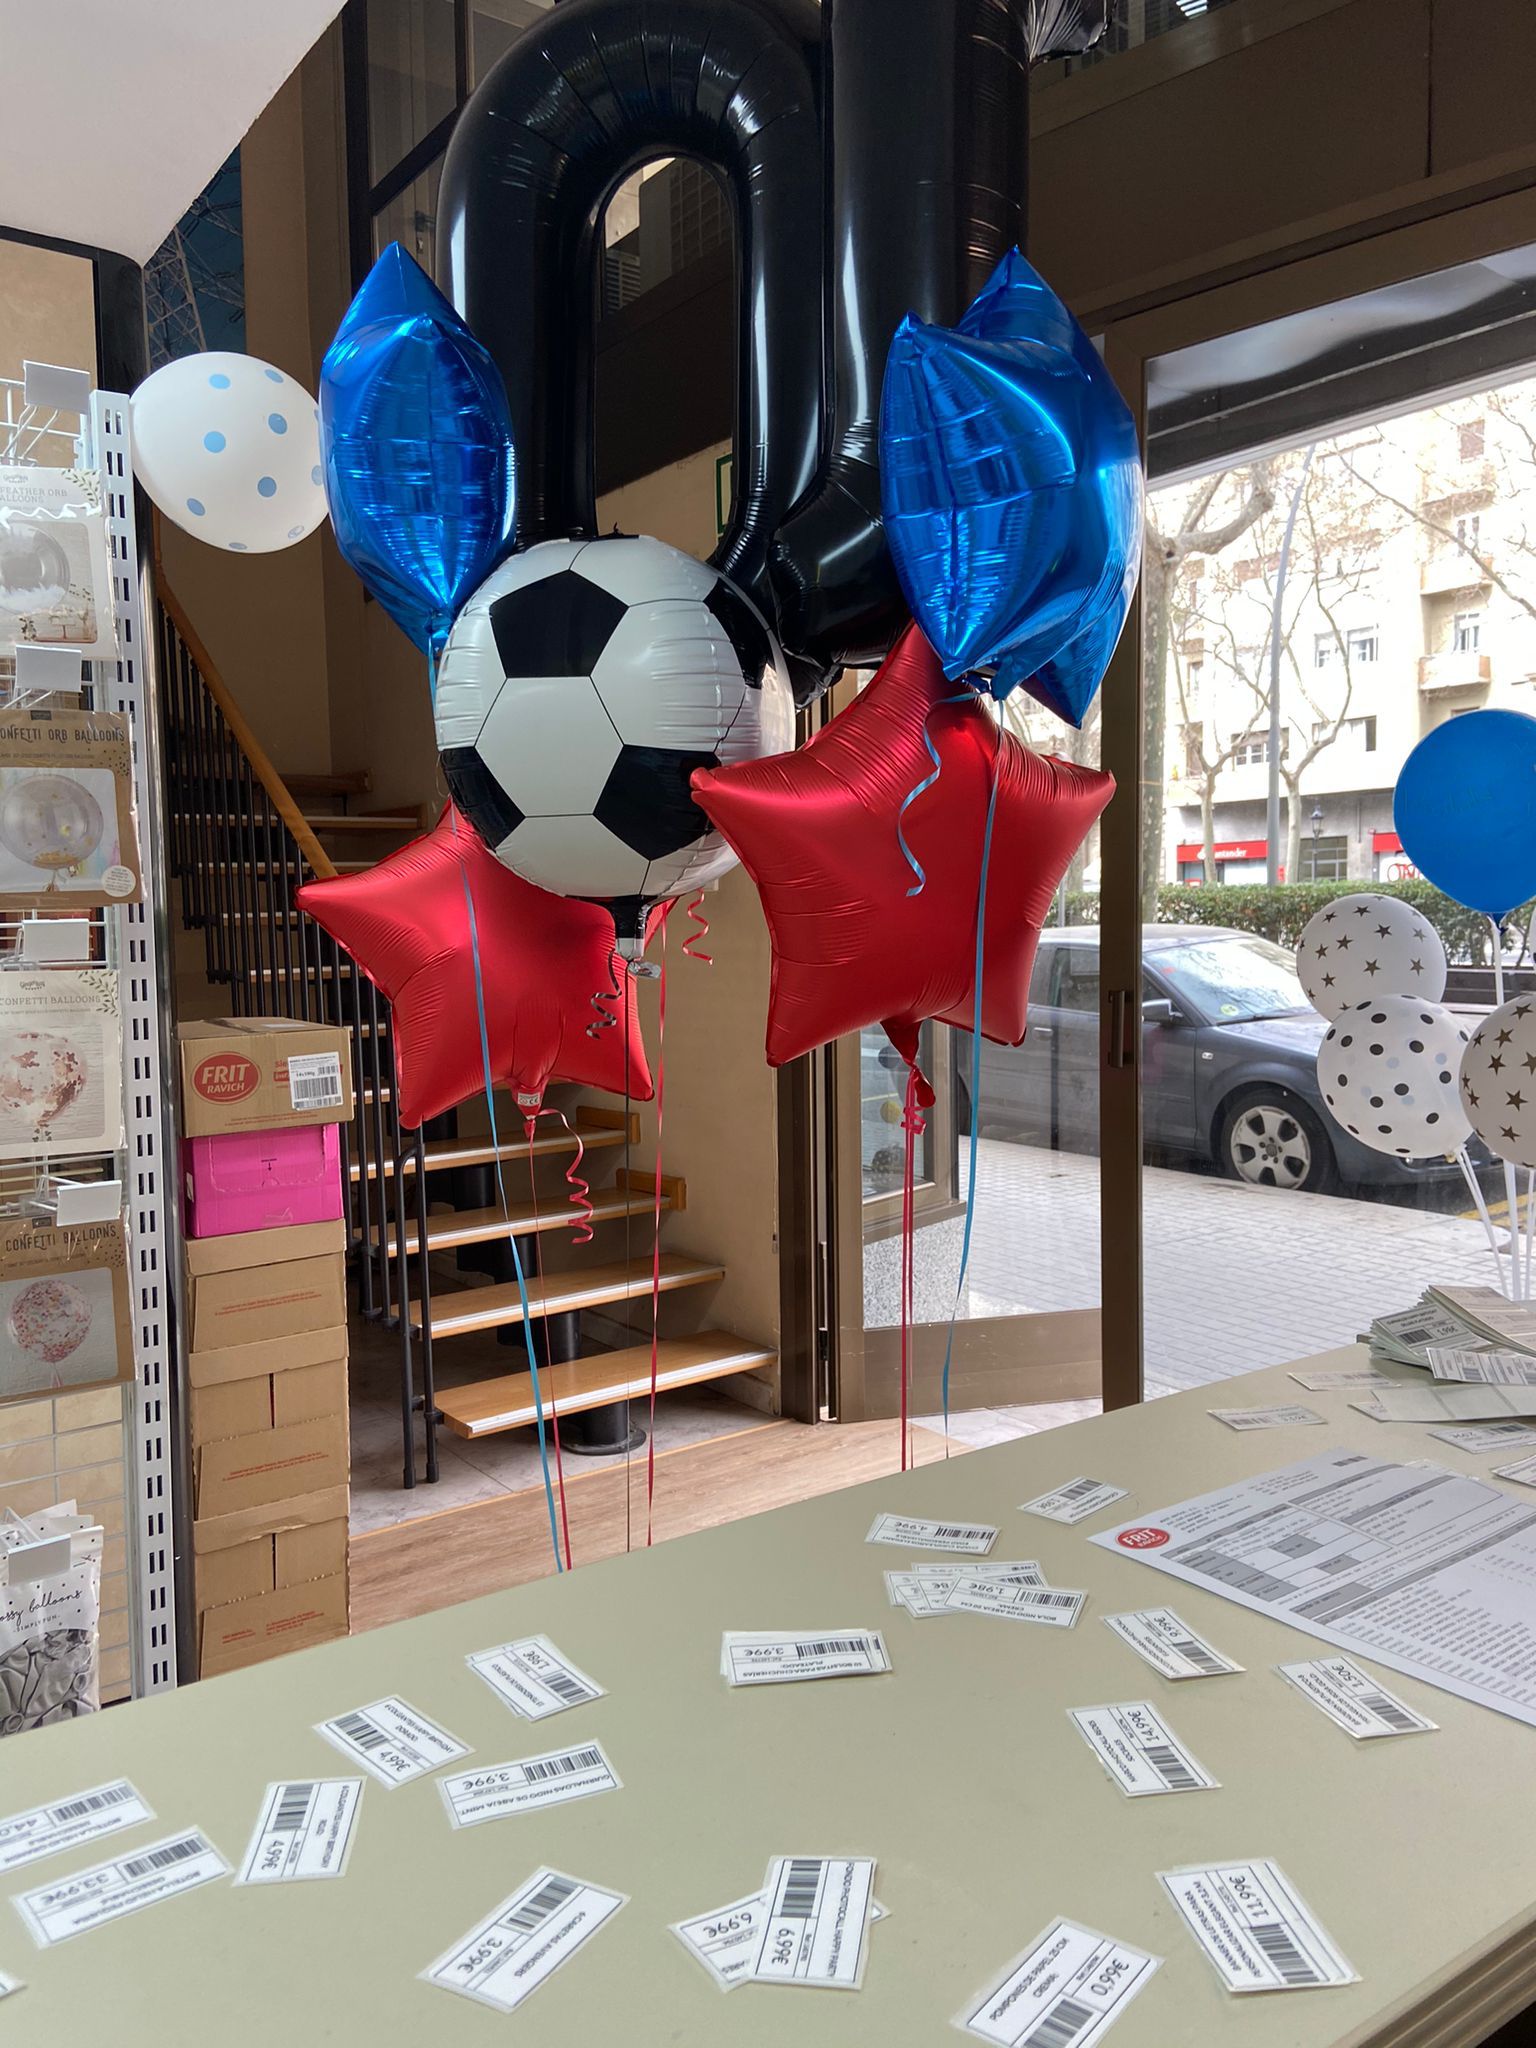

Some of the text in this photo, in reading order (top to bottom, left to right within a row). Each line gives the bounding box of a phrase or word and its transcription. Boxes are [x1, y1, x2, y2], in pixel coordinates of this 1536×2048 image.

[0, 495, 44, 504] ALLOONS
[47, 488, 68, 497] ORB
[0, 723, 125, 744] ONFETTI ORB BALLOONS
[50, 994, 101, 1004] BALLOONS
[201, 1063, 250, 1085] FRIT
[207, 1082, 245, 1095] RAVICH
[5, 1233, 56, 1251] CONFETTI
[63, 1222, 117, 1246] BALLOONS
[1122, 1528, 1158, 1547] FRIT
[29, 1590, 83, 1613] balloons
[745, 1648, 784, 1656] 3,99€
[1332, 1665, 1364, 1687] 1,50€
[1128, 1711, 1159, 1741] 14,99€
[380, 1752, 410, 1772] 4,99€
[1114, 1739, 1135, 1762] SOCIALES
[463, 1773, 509, 1790] 3,99€
[553, 1773, 612, 1792] GUIRNALDAS
[486, 1798, 514, 1807] ABEJA
[514, 1793, 530, 1802] DE
[529, 1789, 553, 1798] NIDO
[261, 1840, 284, 1870] 4,99€
[41, 1874, 109, 1905] 33,99€
[155, 1871, 200, 1891] BOTELLA
[1185, 1891, 1201, 1910] PARA
[1229, 1876, 1269, 1917] 11,99€
[827, 1862, 855, 1978] FONDO PHOTOCALL HAPPY PARTY
[1195, 1910, 1216, 1934] LETRAS
[1204, 1900, 1228, 1929] ELEGANT
[703, 1913, 752, 1943] 6,99€
[457, 1938, 502, 1973] 3,99€
[772, 1928, 795, 1965] 6,99€
[1218, 1944, 1241, 1971] BANNER
[1223, 1929, 1262, 1977] PERSONALIZAR
[514, 1943, 552, 1977] AVENGERS
[989, 1983, 1028, 2020] POMPONES
[1021, 1975, 1036, 1986] DE
[1031, 1957, 1054, 1976] PAPEL
[1091, 1959, 1129, 1996] 0,99€
